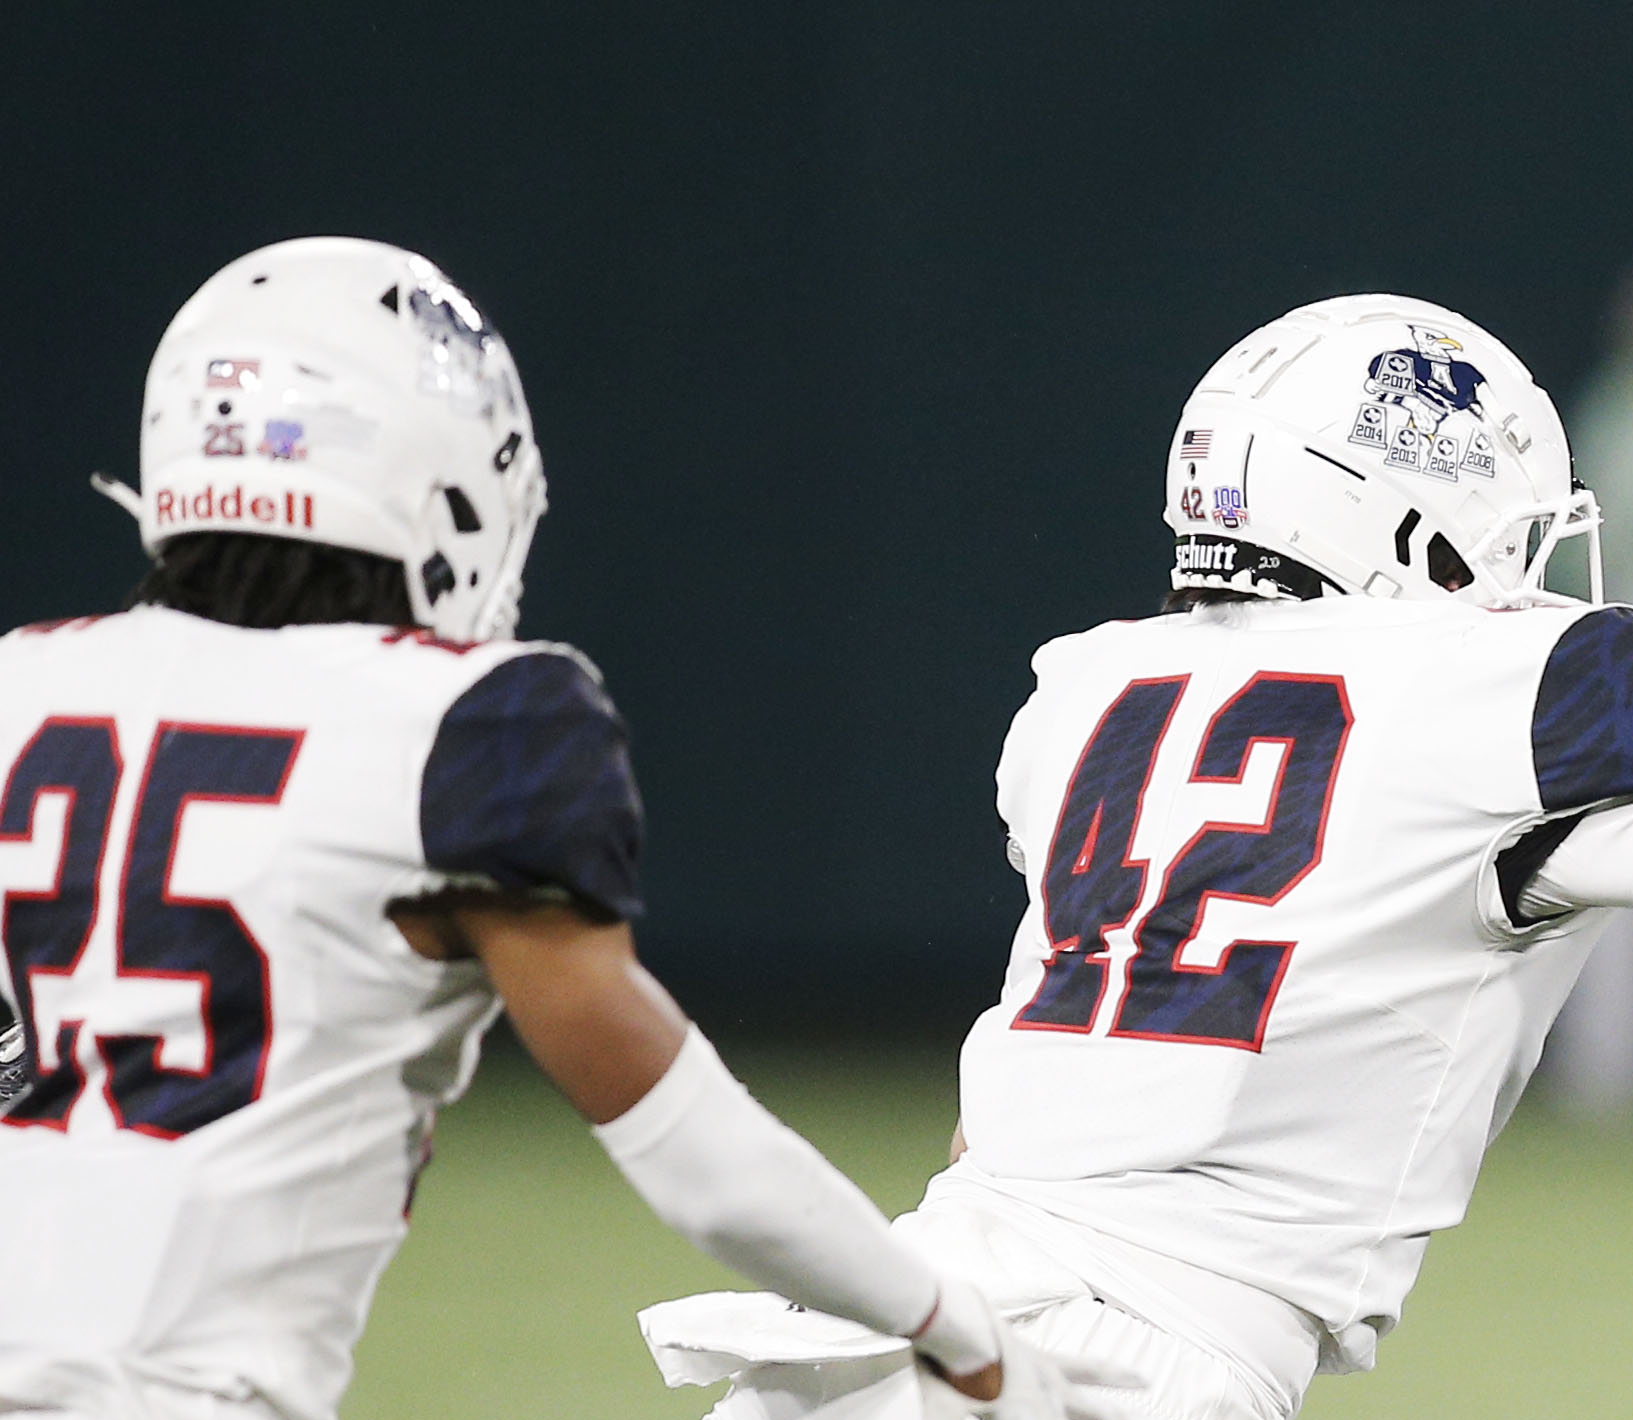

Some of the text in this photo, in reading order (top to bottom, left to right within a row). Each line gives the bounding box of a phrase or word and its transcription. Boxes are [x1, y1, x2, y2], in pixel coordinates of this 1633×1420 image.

[1381, 372, 1413, 390] 2017
[203, 423, 245, 457] 25
[1355, 423, 1383, 442] 2014
[1390, 447, 1418, 465] 2013
[1429, 456, 1456, 476] 2012
[1466, 451, 1492, 470] 2008
[156, 484, 314, 528] Riddell
[1180, 486, 1207, 520] 42
[1213, 487, 1242, 509] 100
[1175, 535, 1238, 571] schutt
[1009, 669, 1355, 1054] 42
[0, 715, 308, 1142] 25
